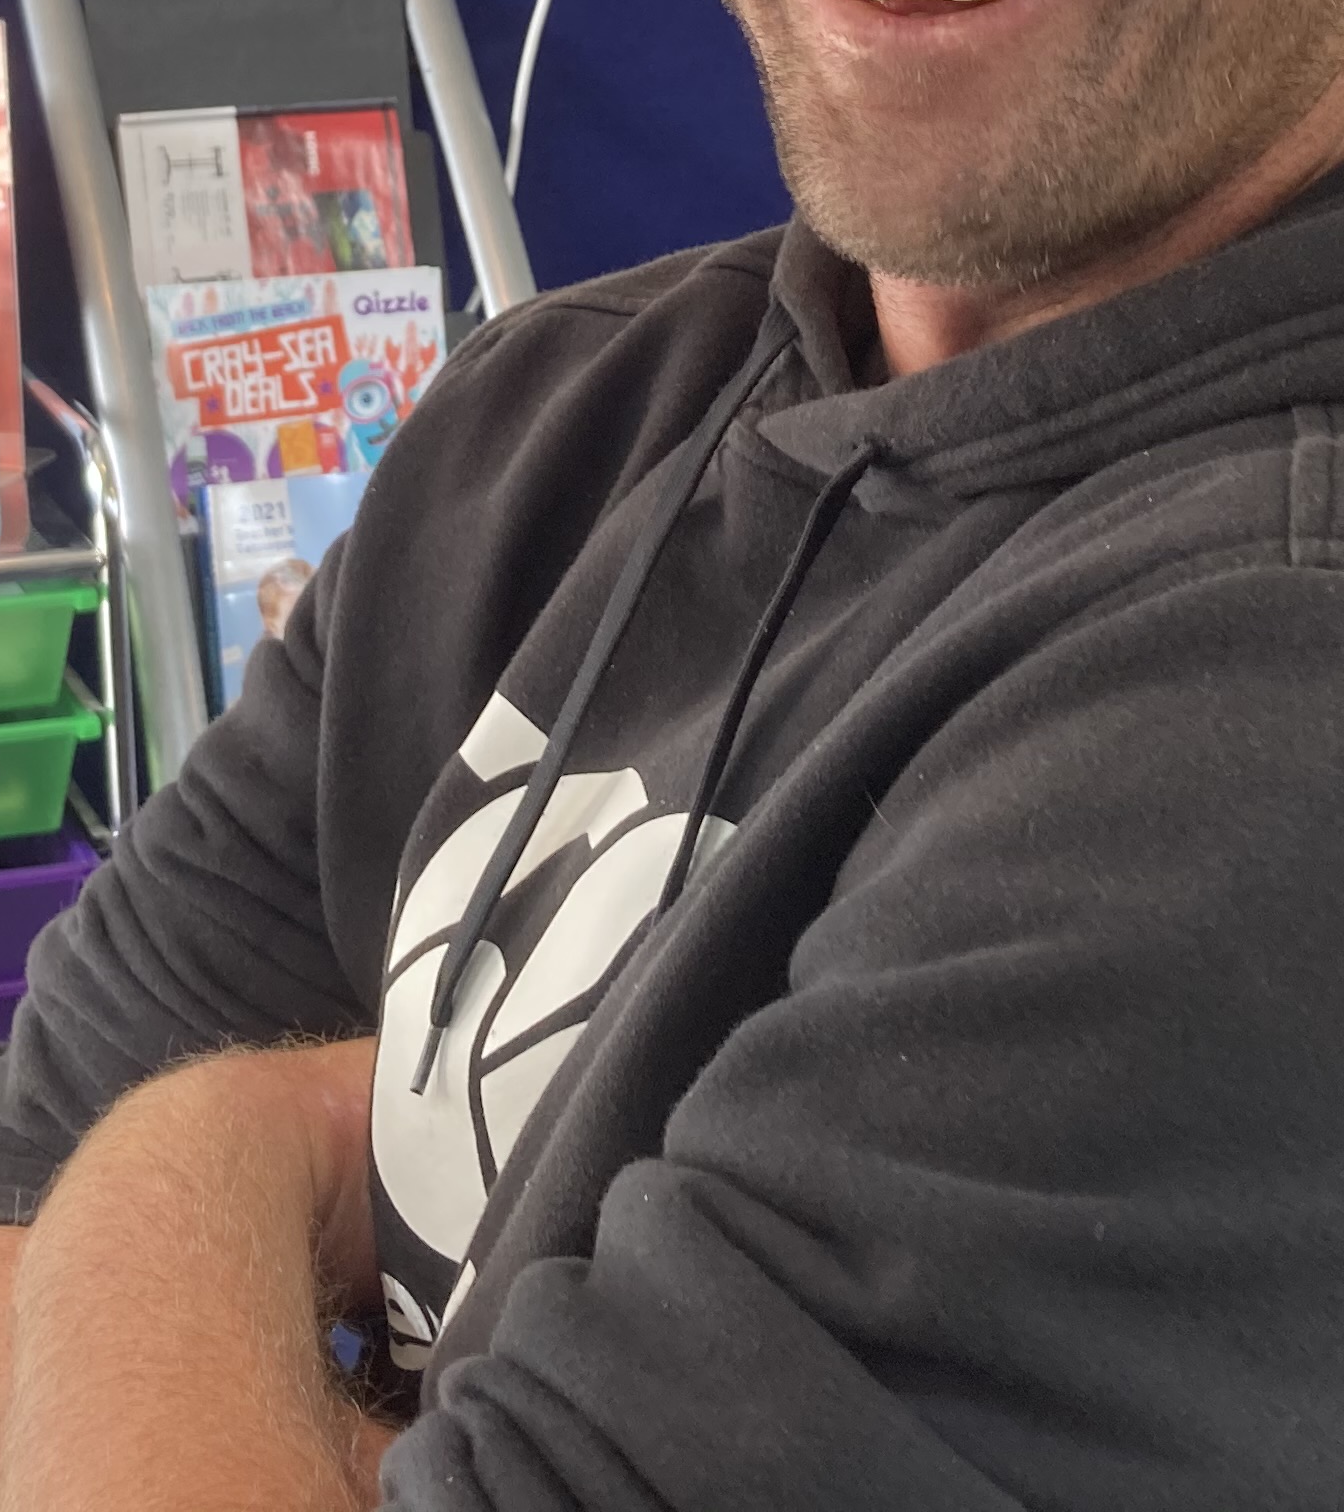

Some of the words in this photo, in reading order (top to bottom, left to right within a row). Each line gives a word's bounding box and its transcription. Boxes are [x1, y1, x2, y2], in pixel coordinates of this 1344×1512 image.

[354, 290, 430, 317] Qizzle
[182, 324, 338, 392] CRAY-SEA
[224, 370, 319, 417] DEALS
[239, 500, 287, 523] 2021
